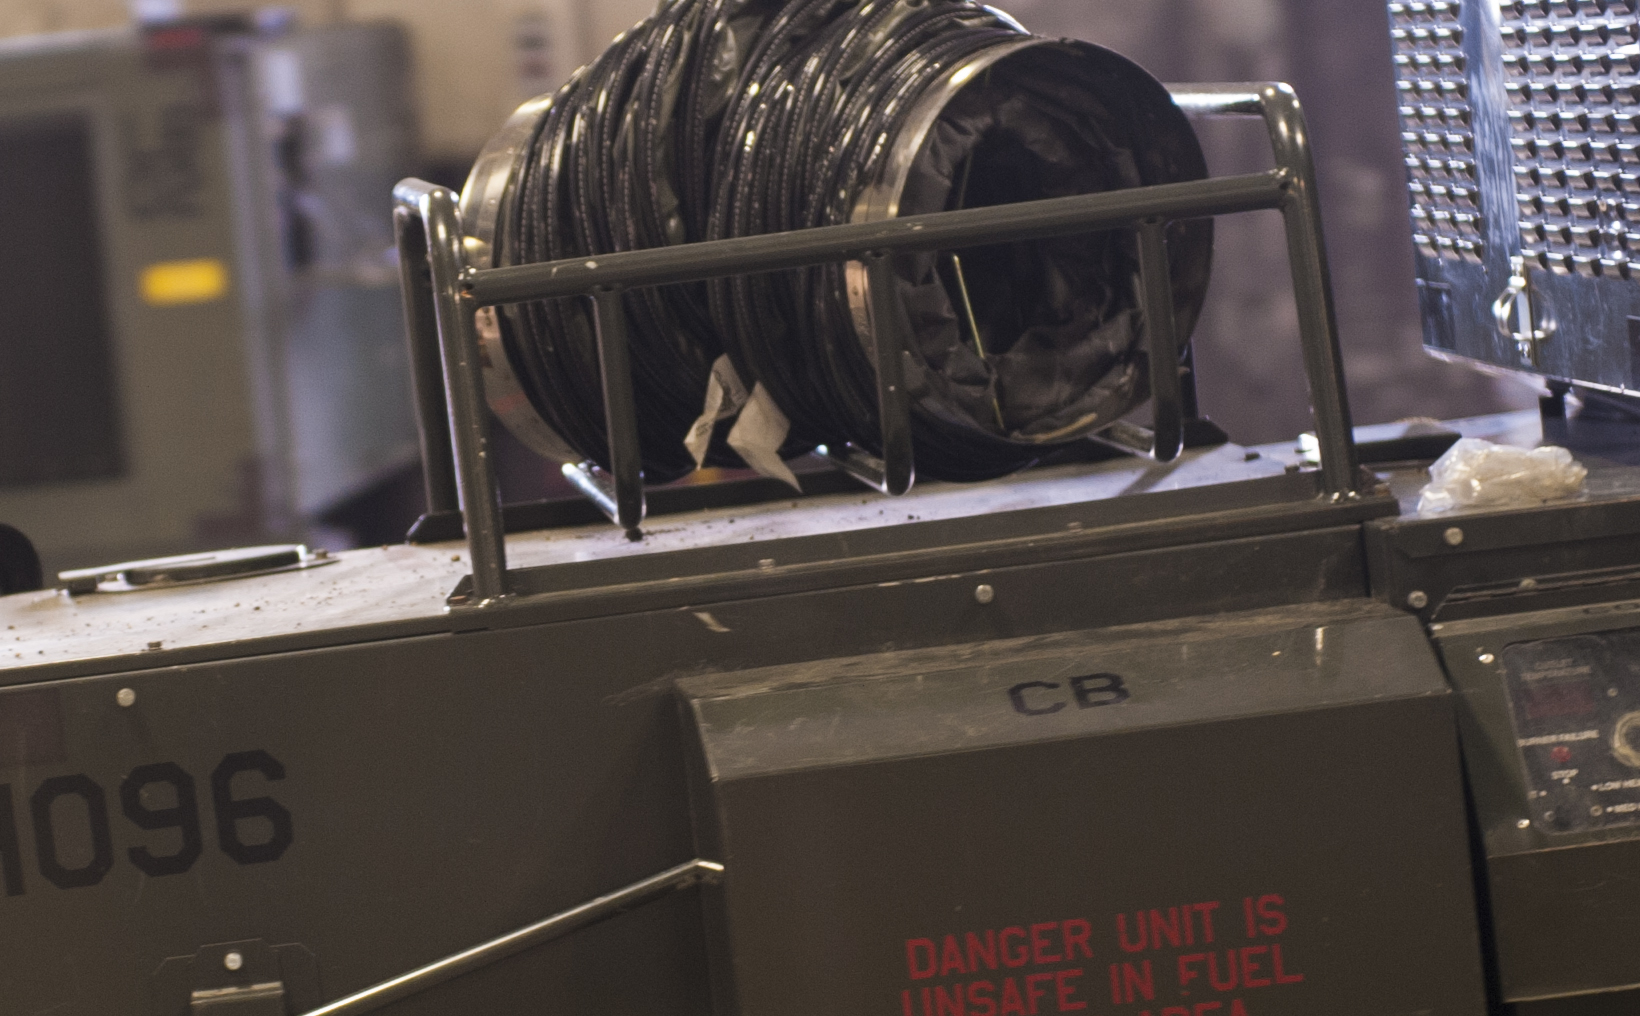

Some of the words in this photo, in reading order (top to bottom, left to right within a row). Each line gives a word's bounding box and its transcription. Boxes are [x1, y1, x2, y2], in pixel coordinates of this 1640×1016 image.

[1007, 672, 1130, 716] CB
[906, 918, 1093, 980] DANGER
[1116, 901, 1220, 952] UNIT
[1243, 894, 1288, 938] IS
[1109, 960, 1155, 1004] IN
[1177, 944, 1305, 996] FUEL
